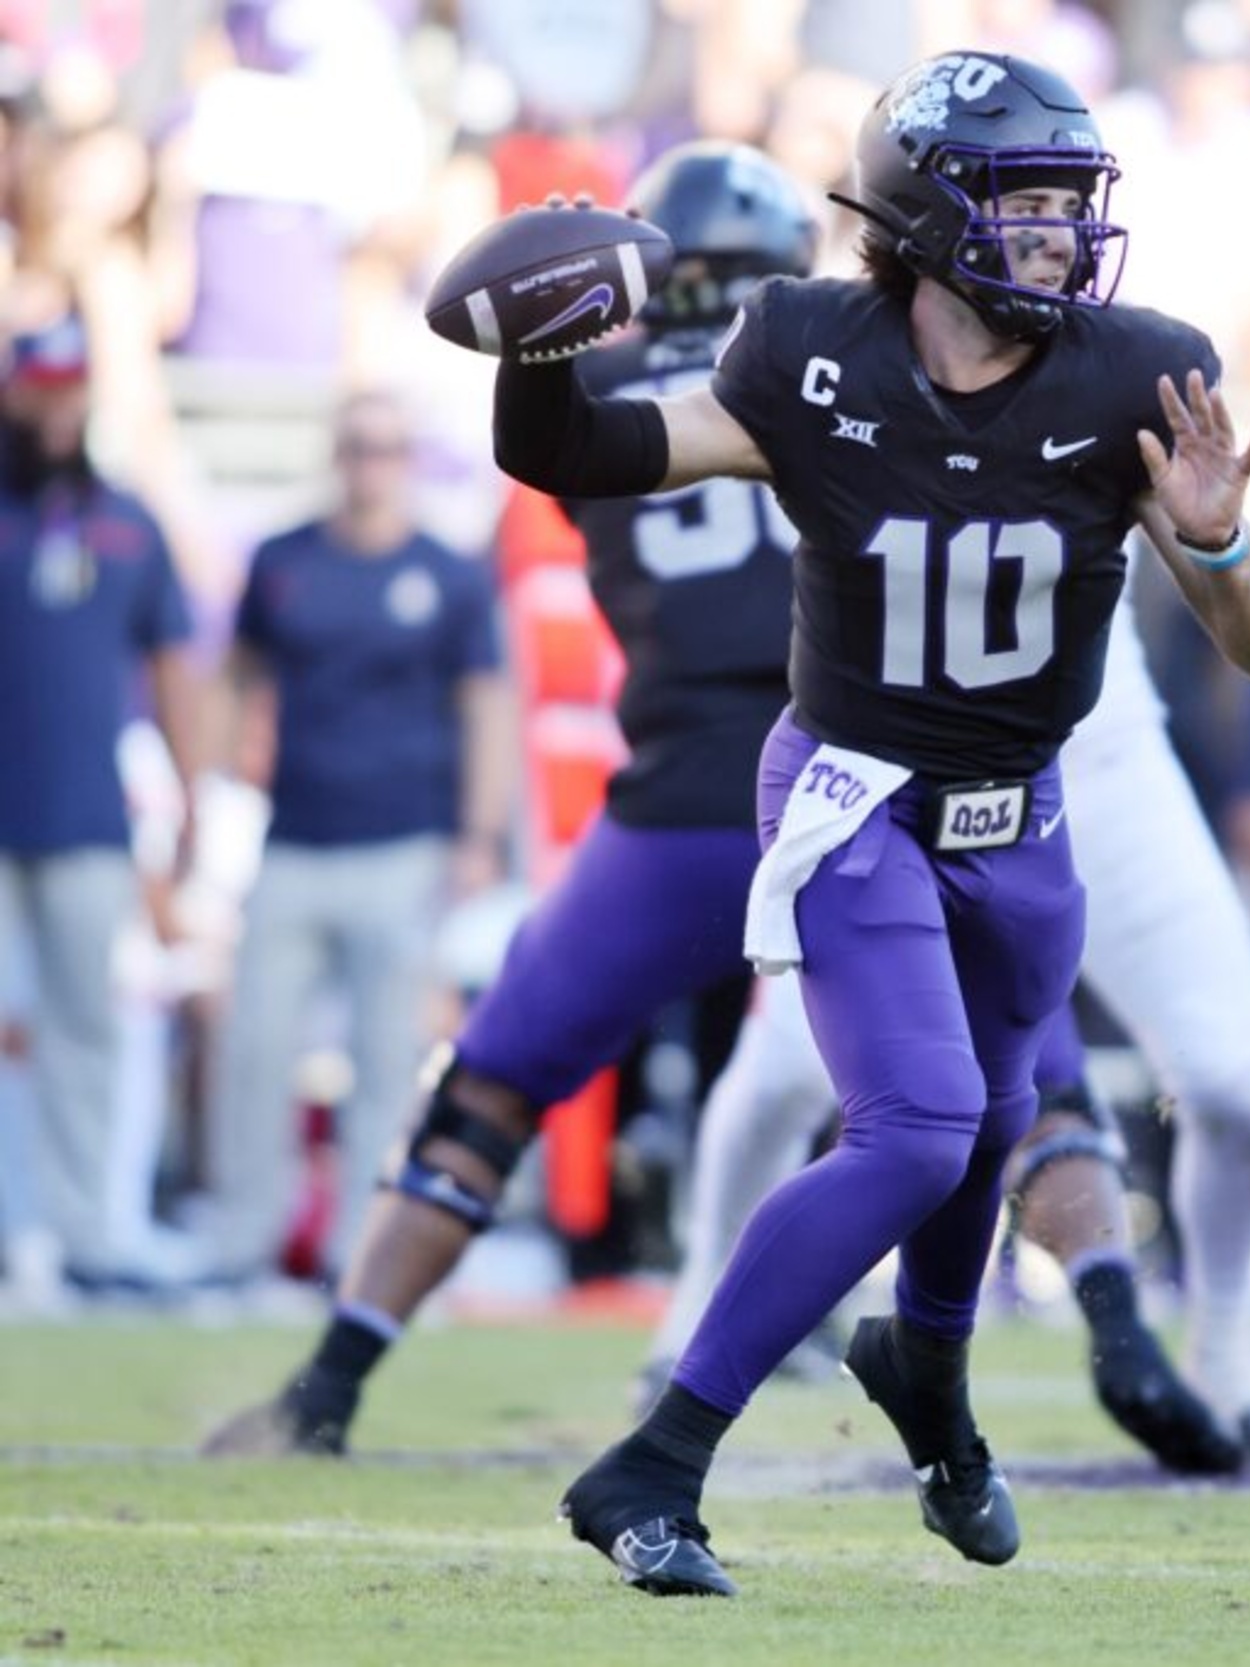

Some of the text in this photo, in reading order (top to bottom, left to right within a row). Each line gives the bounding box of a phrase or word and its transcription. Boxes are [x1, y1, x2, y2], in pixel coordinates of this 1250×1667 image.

[802, 356, 841, 407] C
[830, 413, 881, 447] XII
[946, 454, 979, 471] TCU
[863, 516, 1065, 691] 10
[804, 762, 868, 811] TCU
[950, 797, 1012, 837] TCU
